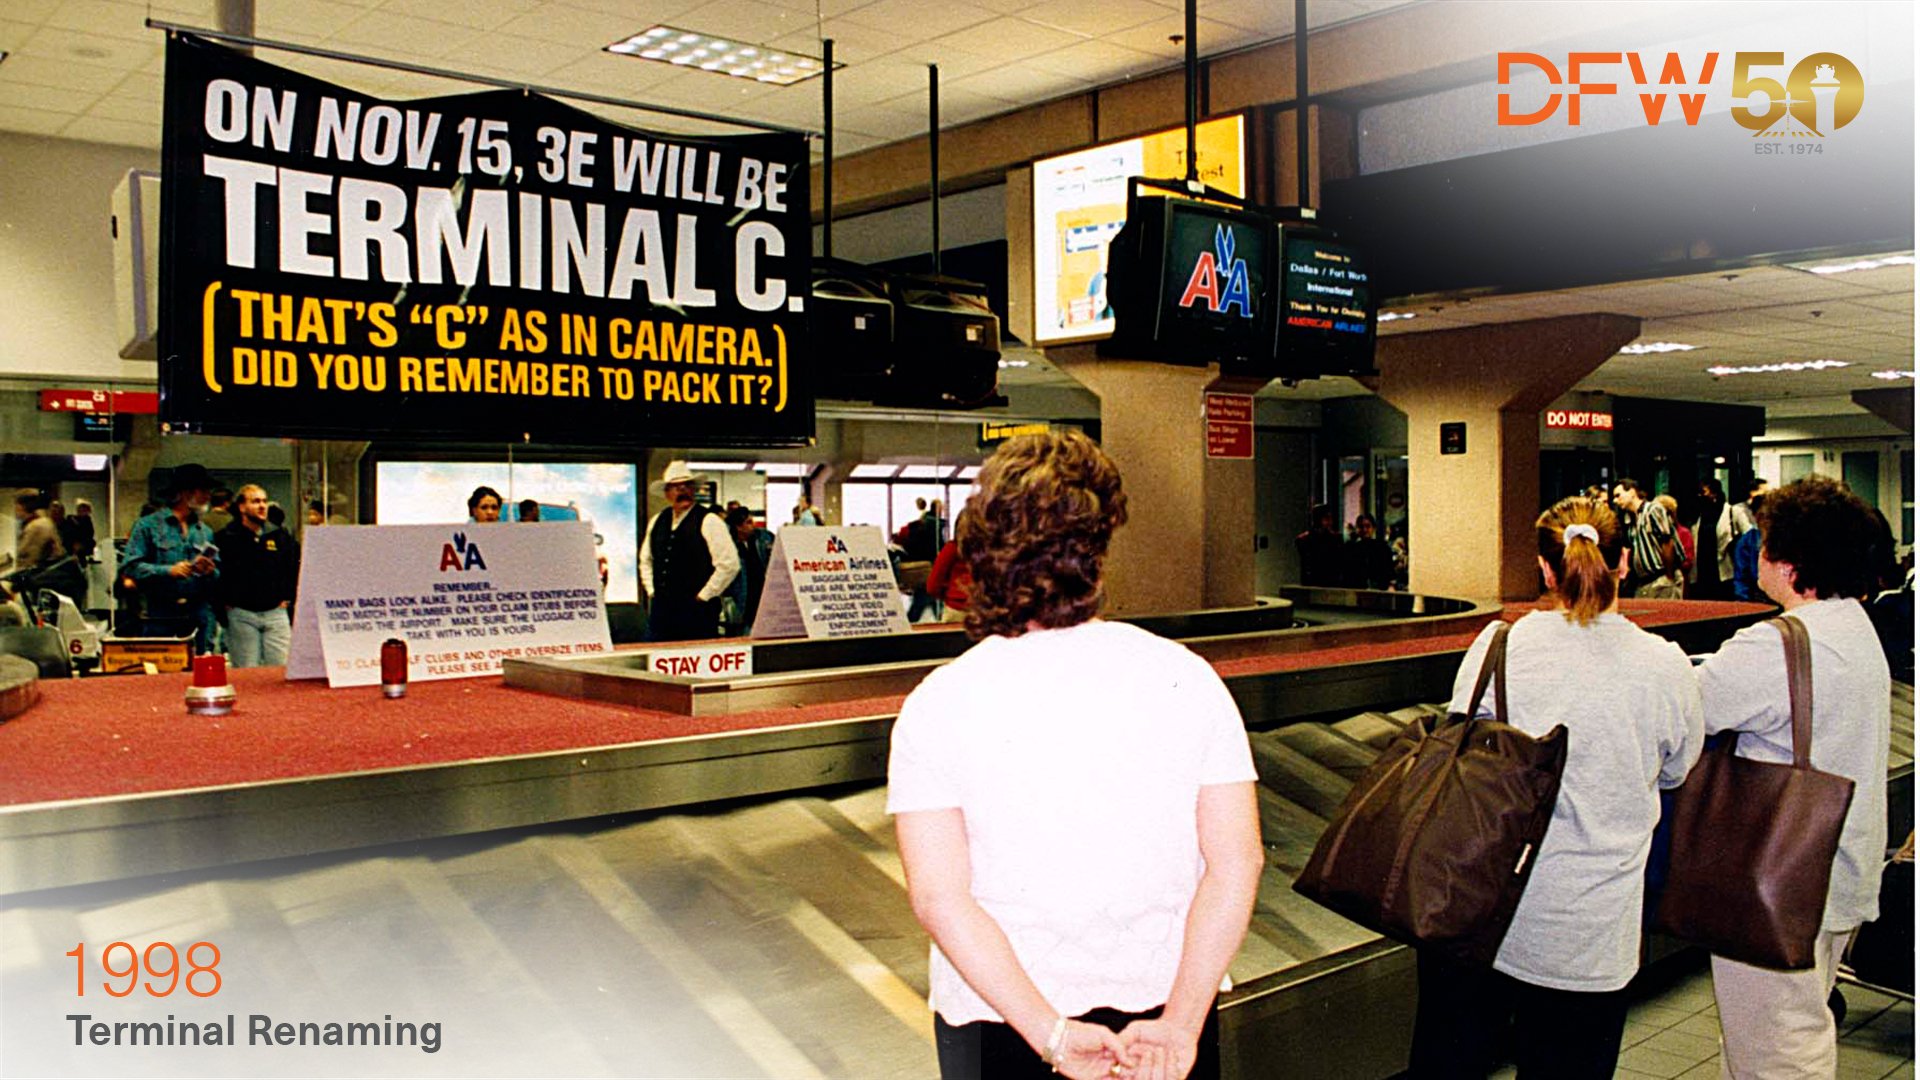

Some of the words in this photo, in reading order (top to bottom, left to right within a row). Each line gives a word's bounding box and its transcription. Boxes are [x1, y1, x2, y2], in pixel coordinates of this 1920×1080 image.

[204, 79, 294, 153] ON
[314, 96, 442, 172] NOV.
[457, 117, 524, 184] 15,
[537, 126, 598, 188] 3E
[612, 136, 725, 205] WILL
[740, 157, 788, 213] BE
[203, 154, 716, 308] TERMINAL
[735, 220, 804, 314] C.
[1290, 262, 1319, 275] Dallas
[1329, 267, 1346, 279] Fort
[1179, 248, 1254, 318] AA
[1306, 282, 1354, 297] International
[232, 289, 398, 349] THAT'S
[500, 310, 548, 353] AS
[561, 314, 597, 357] IN
[609, 318, 774, 367] CAMERA.
[233, 348, 298, 389] DID
[308, 353, 386, 392] YOU
[400, 356, 590, 398] REMEMBER
[596, 367, 633, 400] TO
[643, 369, 720, 404] PACK
[729, 374, 774, 405] IT?
[1547, 411, 1566, 426] DO
[1569, 411, 1590, 426] NOT
[440, 541, 487, 571] AA
[793, 558, 847, 573] American
[849, 557, 888, 570] Airlines
[811, 573, 849, 583] BAGGAGE
[852, 573, 878, 582] CLAIM
[799, 584, 827, 594] AREAS
[829, 583, 845, 592] ARE
[324, 599, 354, 609] MANY
[358, 597, 387, 607] BAGS
[389, 596, 417, 606] LOOK
[457, 593, 493, 603] PLEASE
[496, 591, 527, 601] CHECK
[530, 589, 597, 600] IDENTIFICATION
[810, 592, 870, 602] SURVEILLANCE
[328, 610, 349, 620] AND
[352, 610, 387, 619] MATCH
[389, 608, 409, 617] THE
[412, 606, 452, 616] NUMBER
[455, 605, 471, 615] ON
[474, 604, 498, 614] YOUR
[501, 602, 529, 613] CLAIM
[531, 601, 561, 611] STUBS
[563, 599, 597, 610] BEFORE
[822, 602, 857, 611] INCLUDE
[860, 601, 884, 610] VIDEO
[376, 620, 395, 630] THE
[451, 616, 479, 626] MAKE
[482, 614, 508, 625] SURE
[511, 613, 530, 623] THE
[533, 611, 574, 622] LUGGAGE
[578, 610, 598, 620] YOU
[813, 611, 859, 622] EQUIPMENT
[862, 610, 880, 619] AND
[406, 631, 431, 640] TAKE
[435, 629, 462, 639] WITH
[465, 627, 486, 637] YOU
[488, 626, 500, 636] IS
[502, 624, 537, 635] YOURS
[828, 619, 888, 630] ENFORCEMENT
[69, 639, 83, 655] 6
[424, 651, 460, 664] CLUBS
[464, 650, 486, 660] AND
[488, 647, 522, 659] OTHER
[525, 645, 571, 657] OVERSIZE
[428, 663, 467, 674] PLEASE
[471, 662, 490, 672] SEE
[655, 656, 701, 676] STAY
[709, 652, 746, 673] OFF
